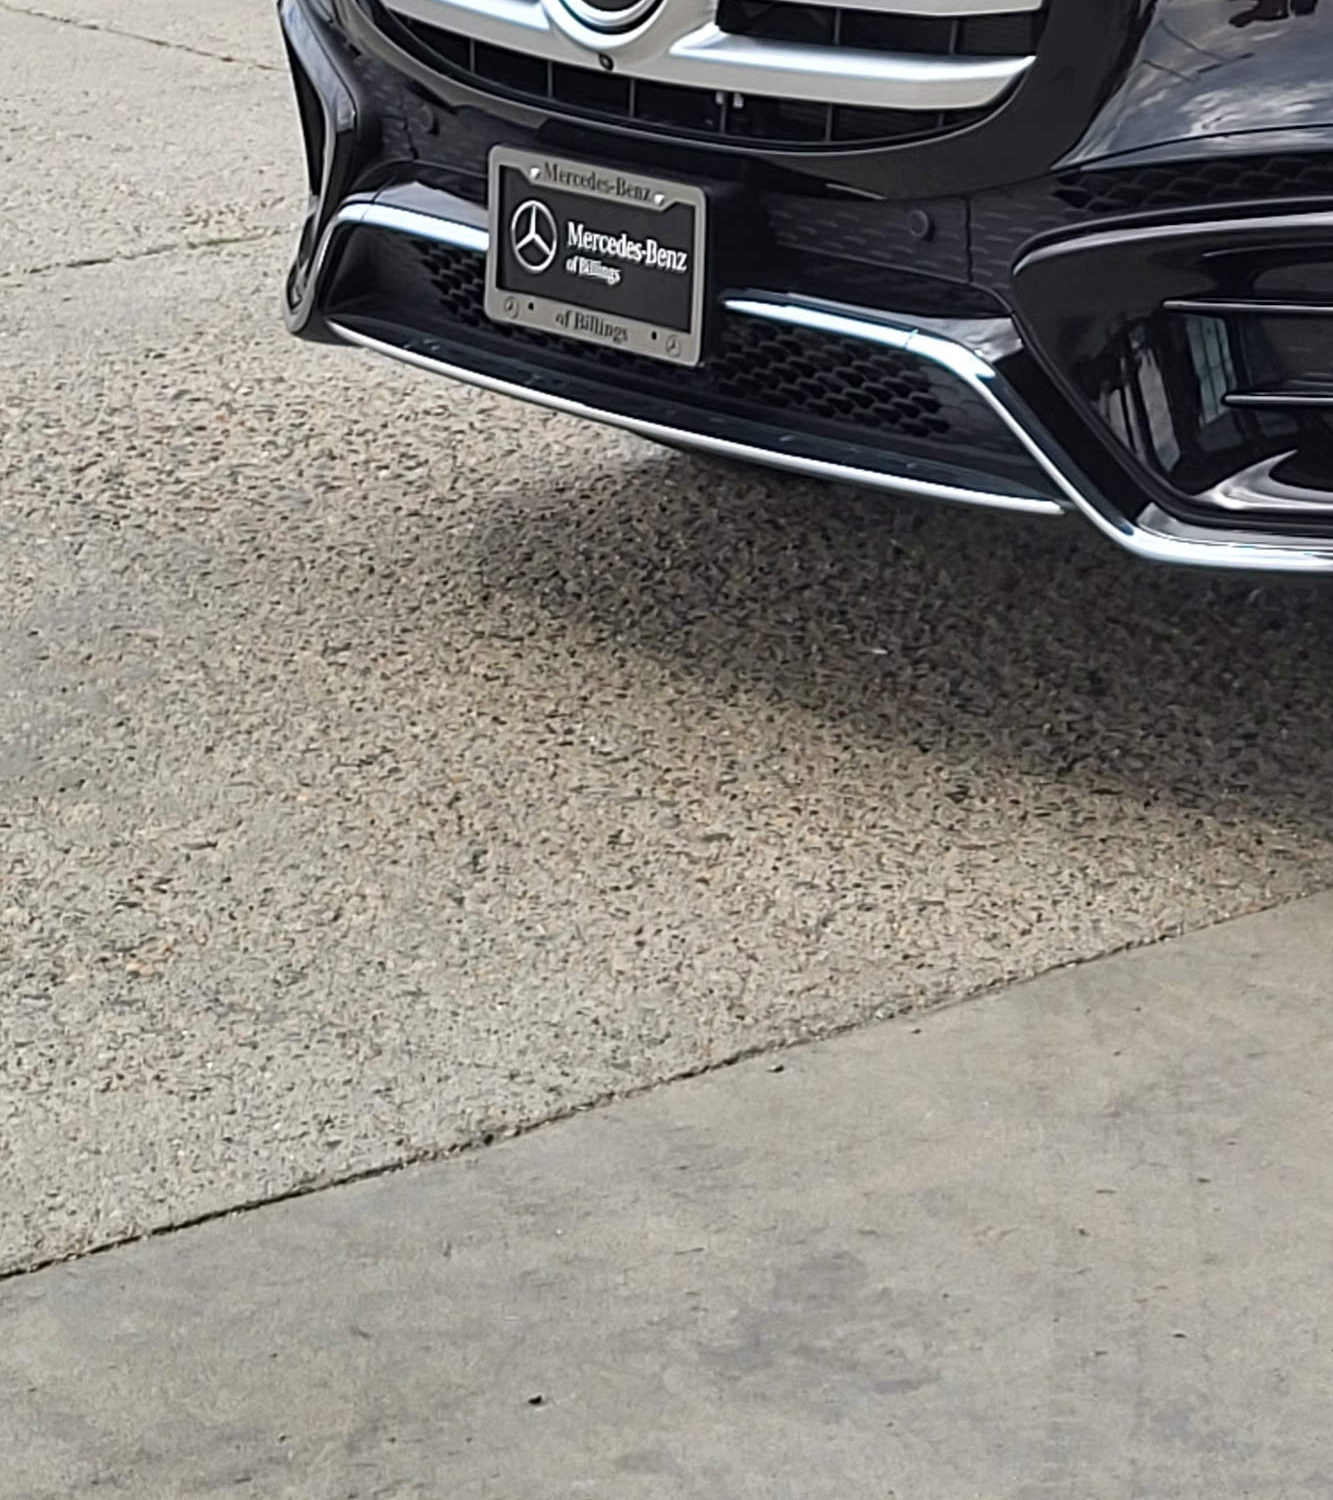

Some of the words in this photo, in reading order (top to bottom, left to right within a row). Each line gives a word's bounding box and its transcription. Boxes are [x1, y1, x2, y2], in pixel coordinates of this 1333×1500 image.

[544, 162, 651, 202] Mercedes-Benz
[567, 221, 688, 272] Mercedes-Benz
[556, 310, 573, 328] of
[574, 312, 628, 345] Billings
